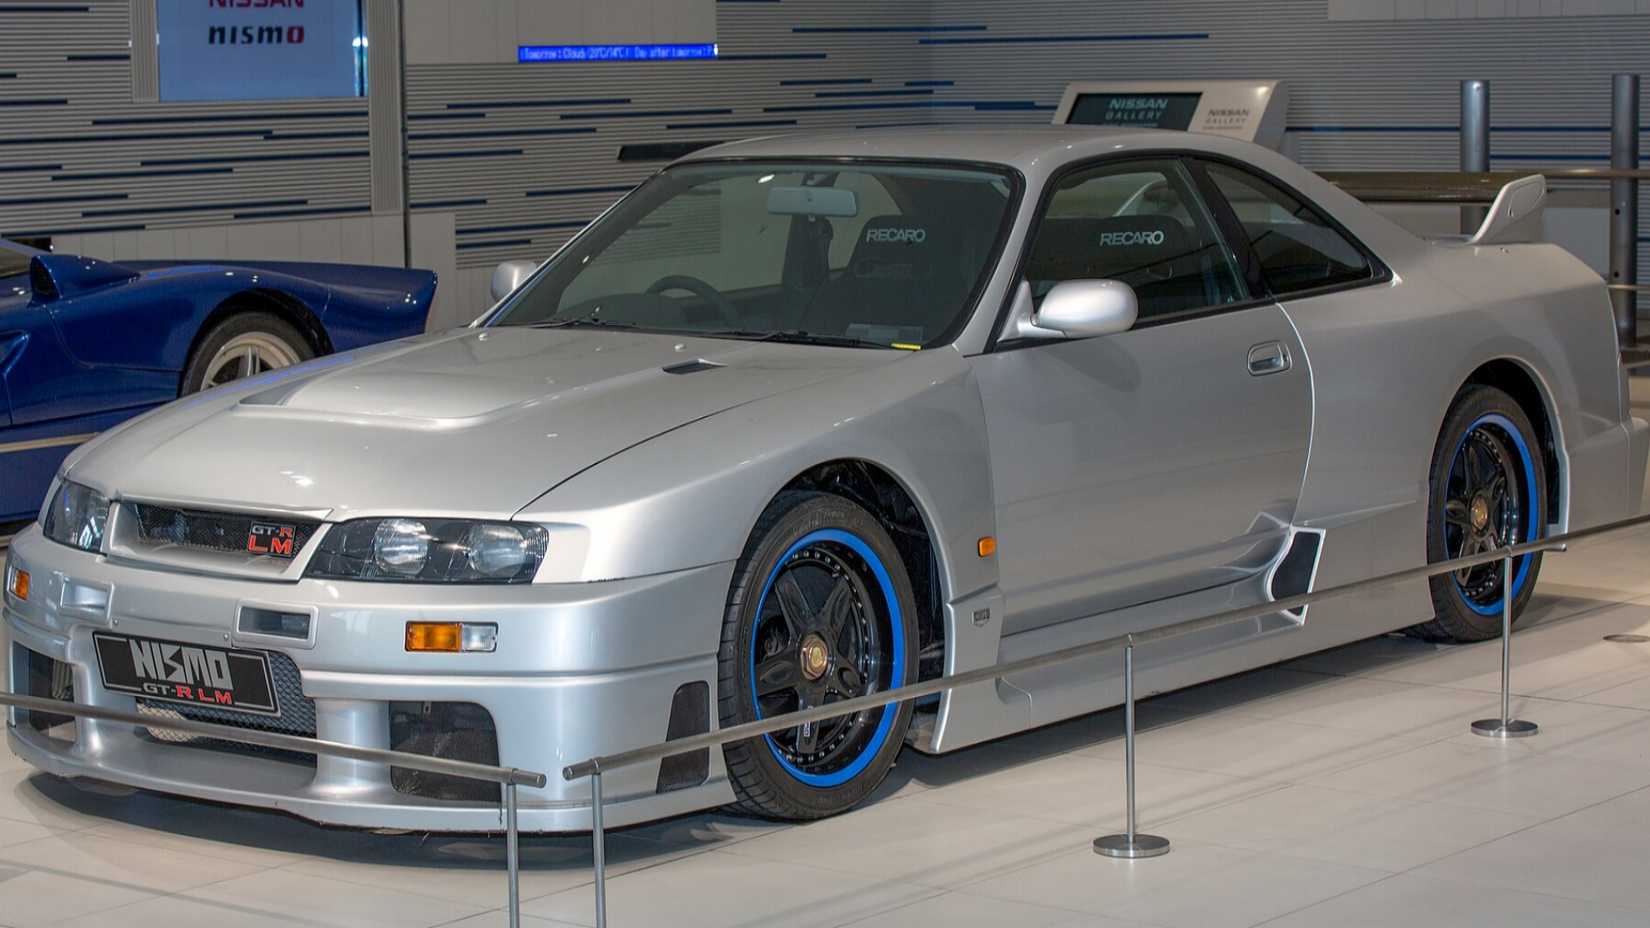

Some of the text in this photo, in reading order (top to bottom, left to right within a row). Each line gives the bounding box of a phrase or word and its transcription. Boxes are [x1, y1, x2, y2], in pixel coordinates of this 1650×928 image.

[1109, 98, 1169, 109] NISSAN
[866, 228, 926, 242] RECARO
[1100, 230, 1164, 246] RECARO
[252, 525, 293, 538] GT-R
[247, 533, 293, 554] LM
[129, 639, 233, 690] NISMO
[143, 682, 233, 705] GT-R LM
